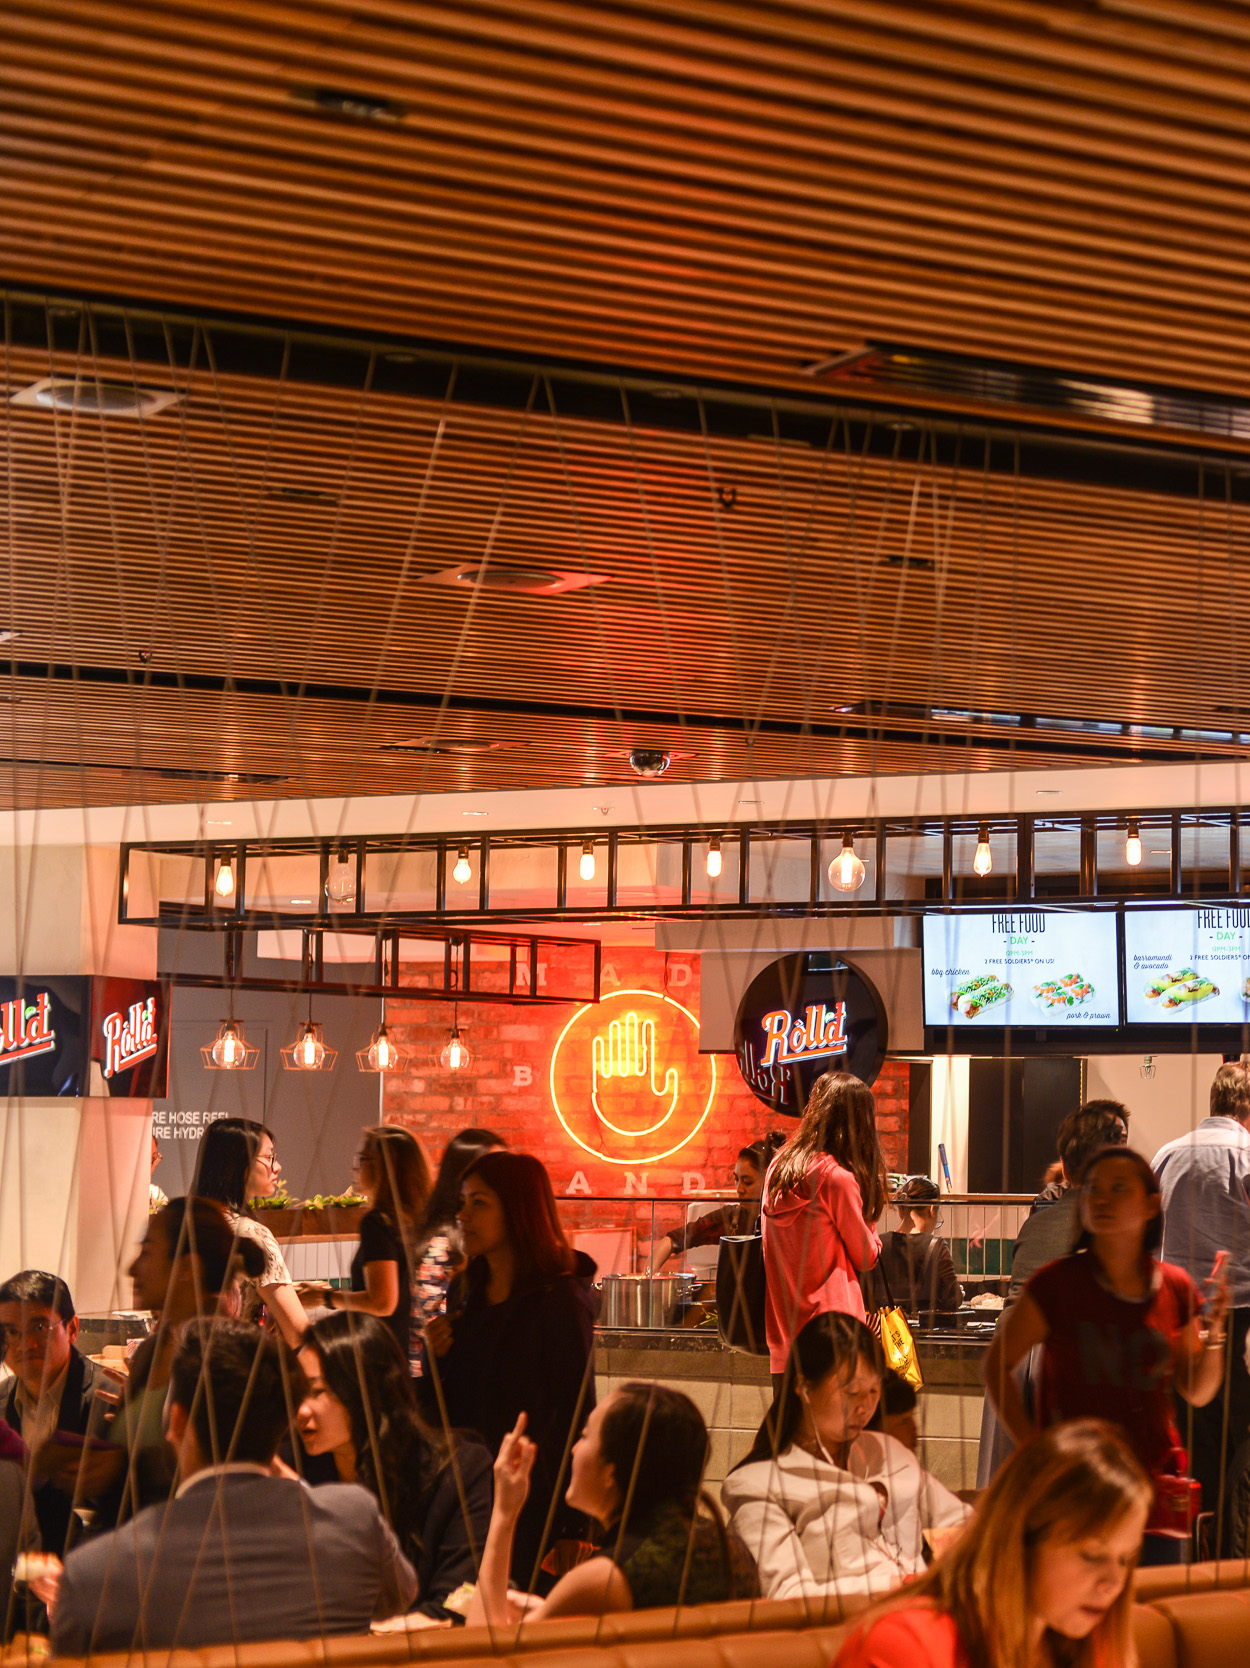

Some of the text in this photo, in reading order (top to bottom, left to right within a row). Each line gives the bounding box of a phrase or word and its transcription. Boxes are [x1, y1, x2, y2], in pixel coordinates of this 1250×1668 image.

[1010, 936, 1029, 945] DAY
[1216, 931, 1236, 941] DAY
[931, 968, 970, 977] bbq chicken
[1066, 1012, 1082, 1020] pork
[152, 1111, 166, 1124] RE
[169, 1111, 200, 1124] HOSE
[153, 1126, 205, 1139] IRE HYDR
